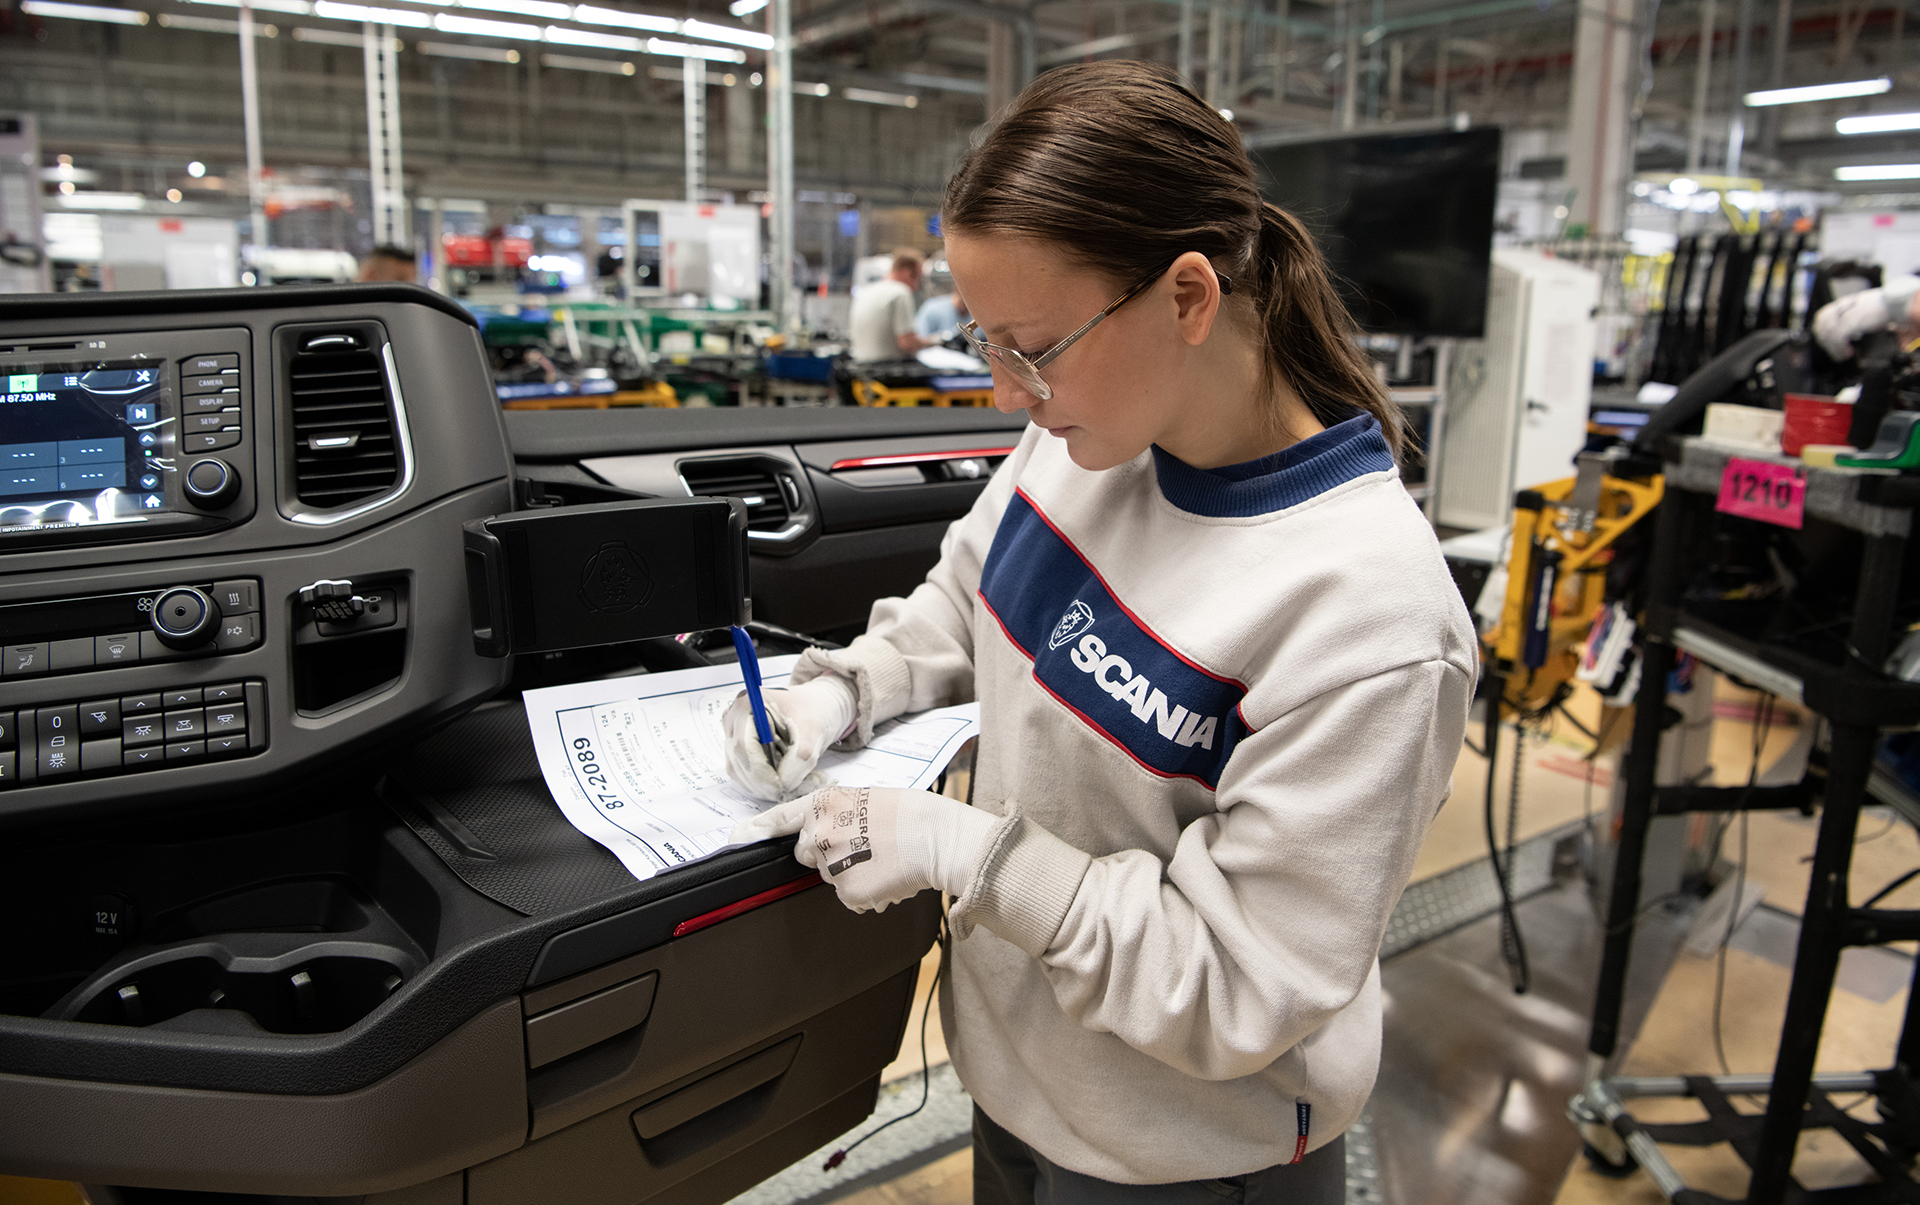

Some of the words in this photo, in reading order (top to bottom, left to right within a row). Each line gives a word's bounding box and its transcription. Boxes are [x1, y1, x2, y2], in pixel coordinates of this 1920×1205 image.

[198, 379, 224, 387] CAMERA
[7, 393, 34, 403] 87.50
[34, 392, 56, 401] MHz
[199, 398, 223, 406] DISPLAY
[200, 417, 220, 425] SETUP
[1731, 470, 1792, 510] 1210
[45, 522, 77, 530] PREMIUM
[1070, 633, 1218, 750] SCANIA
[572, 737, 624, 810] 87-2089
[663, 841, 687, 863] CANIA
[96, 911, 108, 924] 12
[110, 912, 118, 925] V
